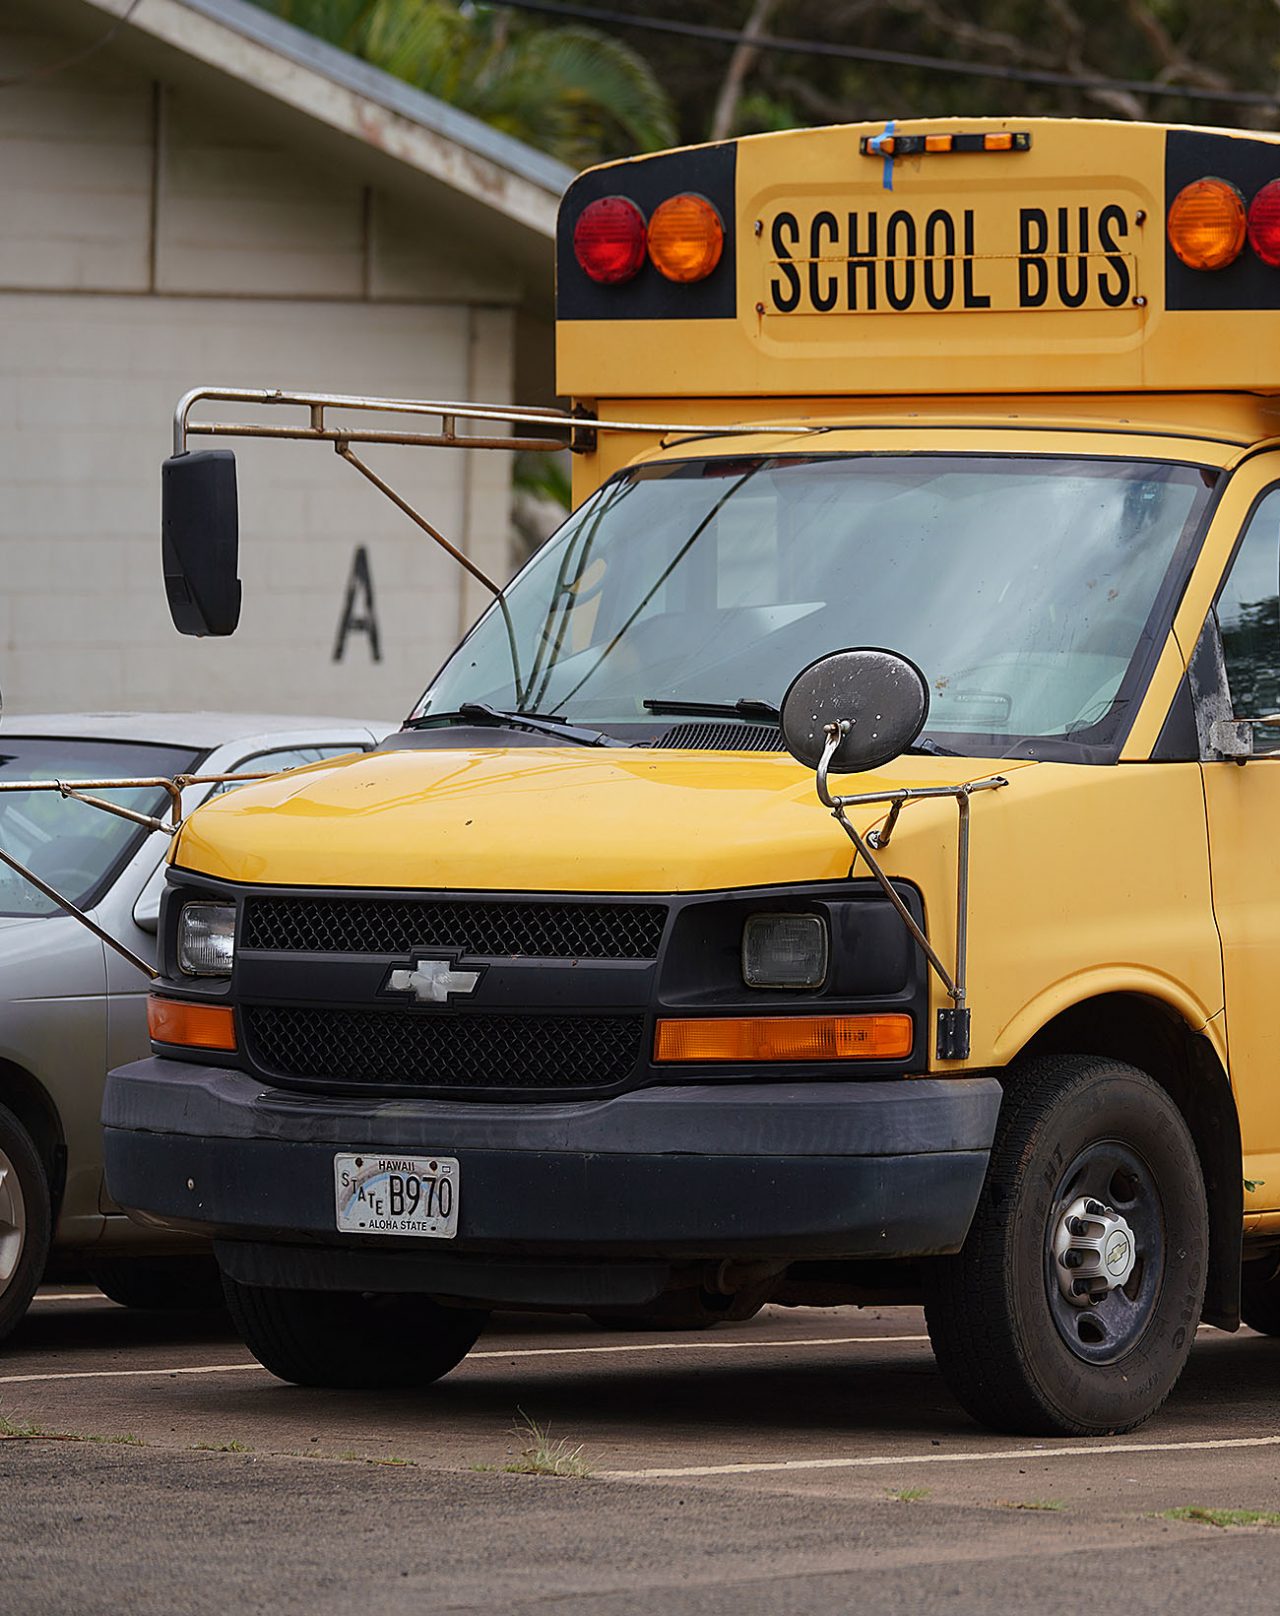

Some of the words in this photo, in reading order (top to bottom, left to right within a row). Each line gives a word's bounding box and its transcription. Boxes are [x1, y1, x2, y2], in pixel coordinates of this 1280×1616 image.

[769, 209, 991, 313] SCHOOL
[1018, 203, 1132, 308] BUS
[331, 544, 382, 663] A
[378, 1160, 415, 1172] HAWAII
[389, 1174, 453, 1219] B970
[369, 1219, 398, 1230] ALOHA
[400, 1220, 427, 1232] STATE
